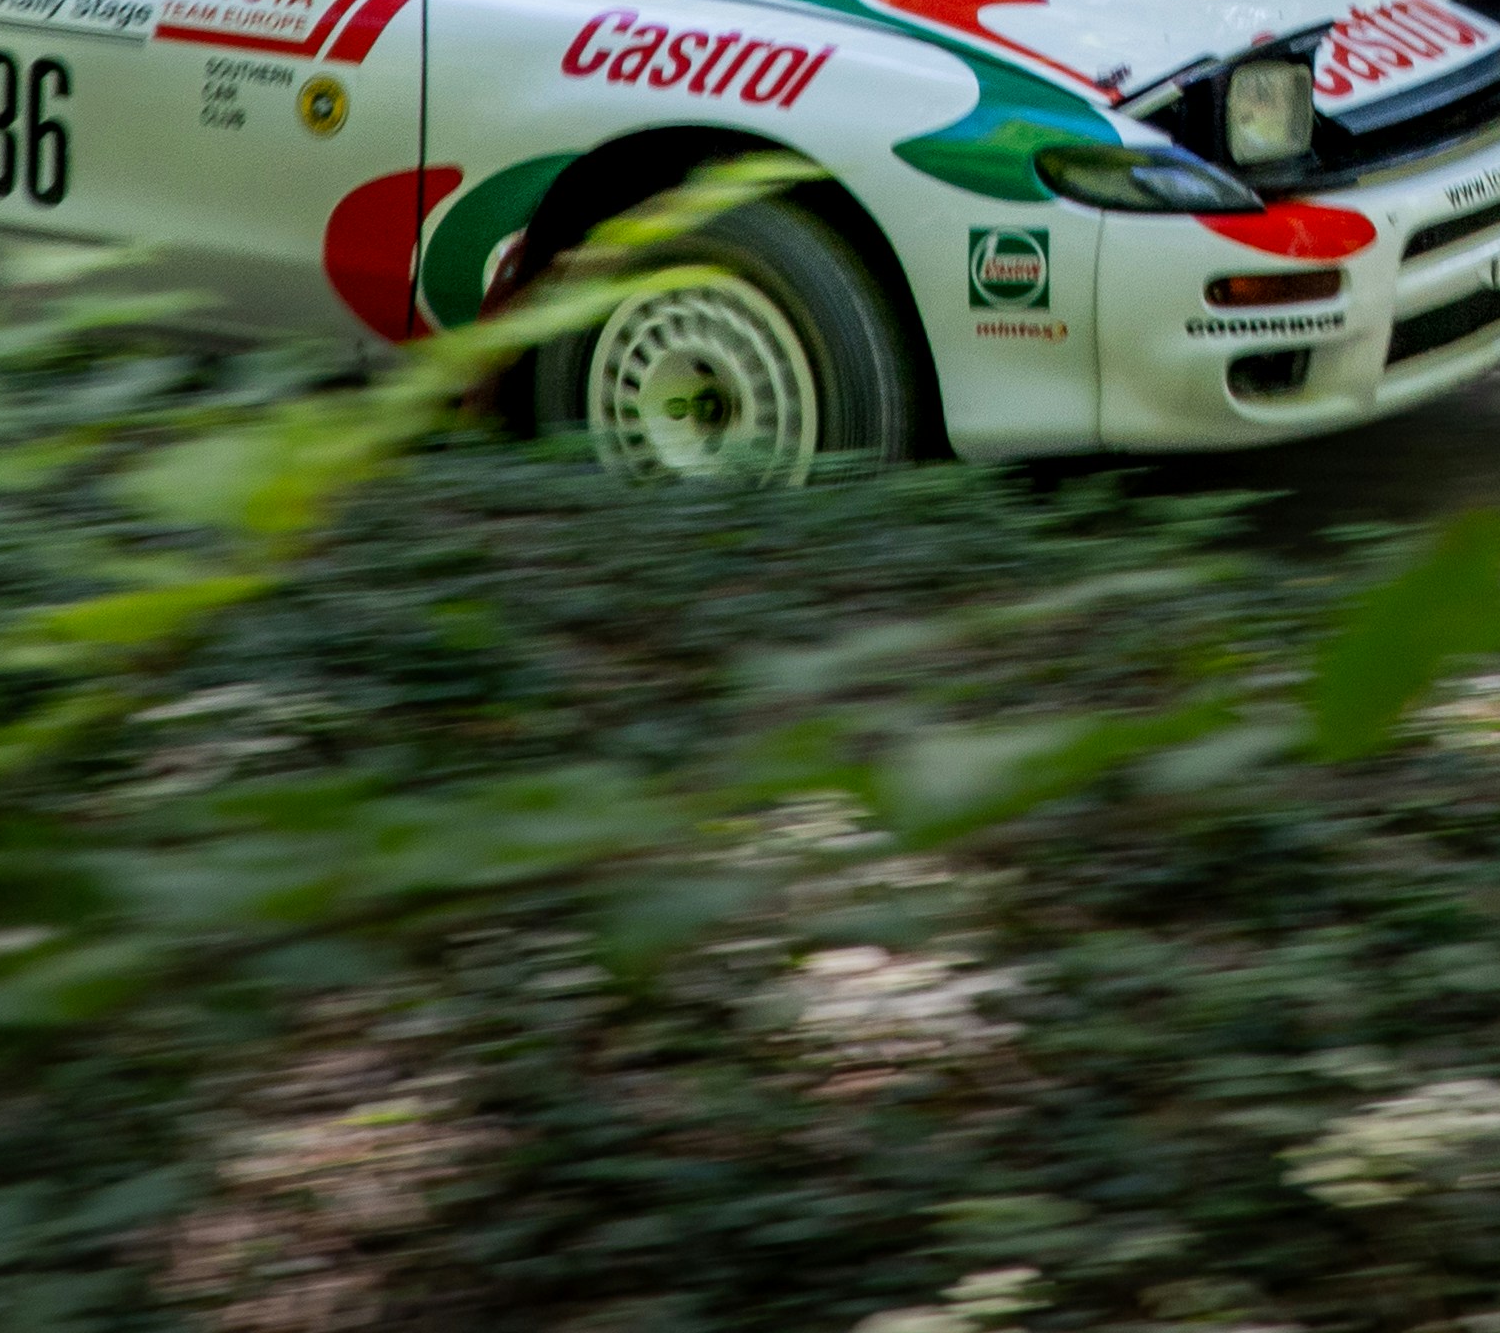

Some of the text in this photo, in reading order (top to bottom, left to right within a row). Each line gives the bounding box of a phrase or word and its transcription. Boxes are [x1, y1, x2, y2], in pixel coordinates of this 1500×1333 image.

[162, 0, 309, 32] TEAM EUROPE
[205, 57, 294, 86] SOUTHERN
[561, 9, 838, 110] Castrol
[1186, 312, 1345, 338] GOODRIDGE
